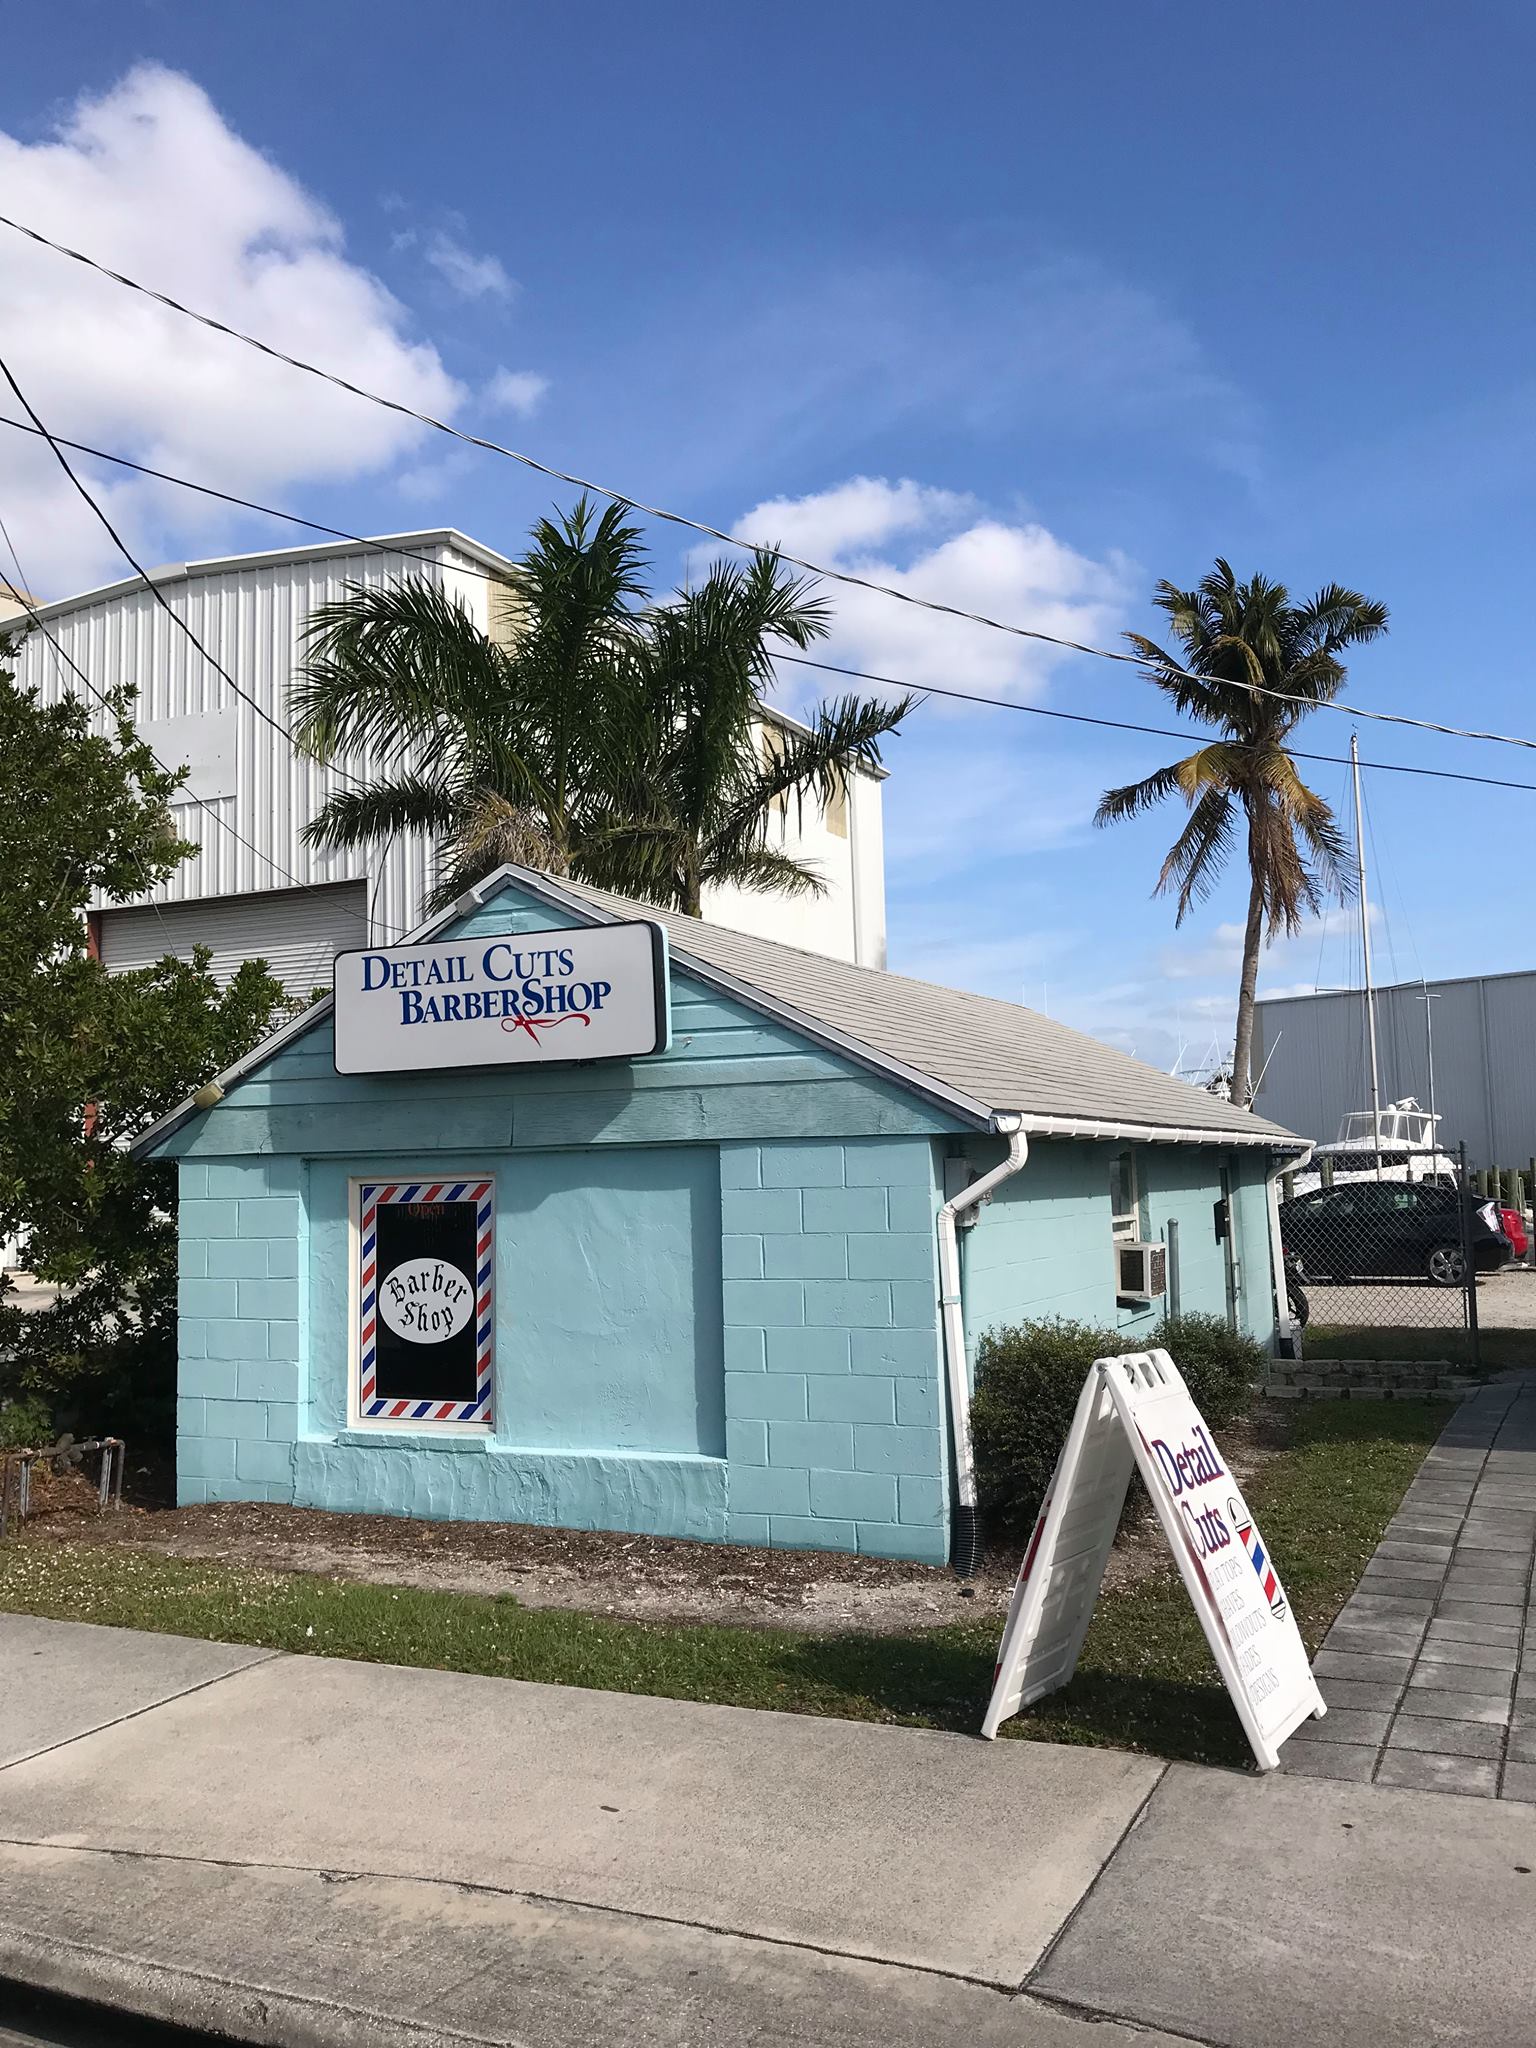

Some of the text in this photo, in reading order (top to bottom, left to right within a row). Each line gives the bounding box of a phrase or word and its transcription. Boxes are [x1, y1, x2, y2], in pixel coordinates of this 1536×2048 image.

[361, 944, 574, 992] DETAIL CUTS
[385, 1264, 467, 1307] Barber
[398, 1300, 454, 1338] Shop
[1151, 1425, 1224, 1497] Detail
[1181, 1500, 1230, 1559] Cuts
